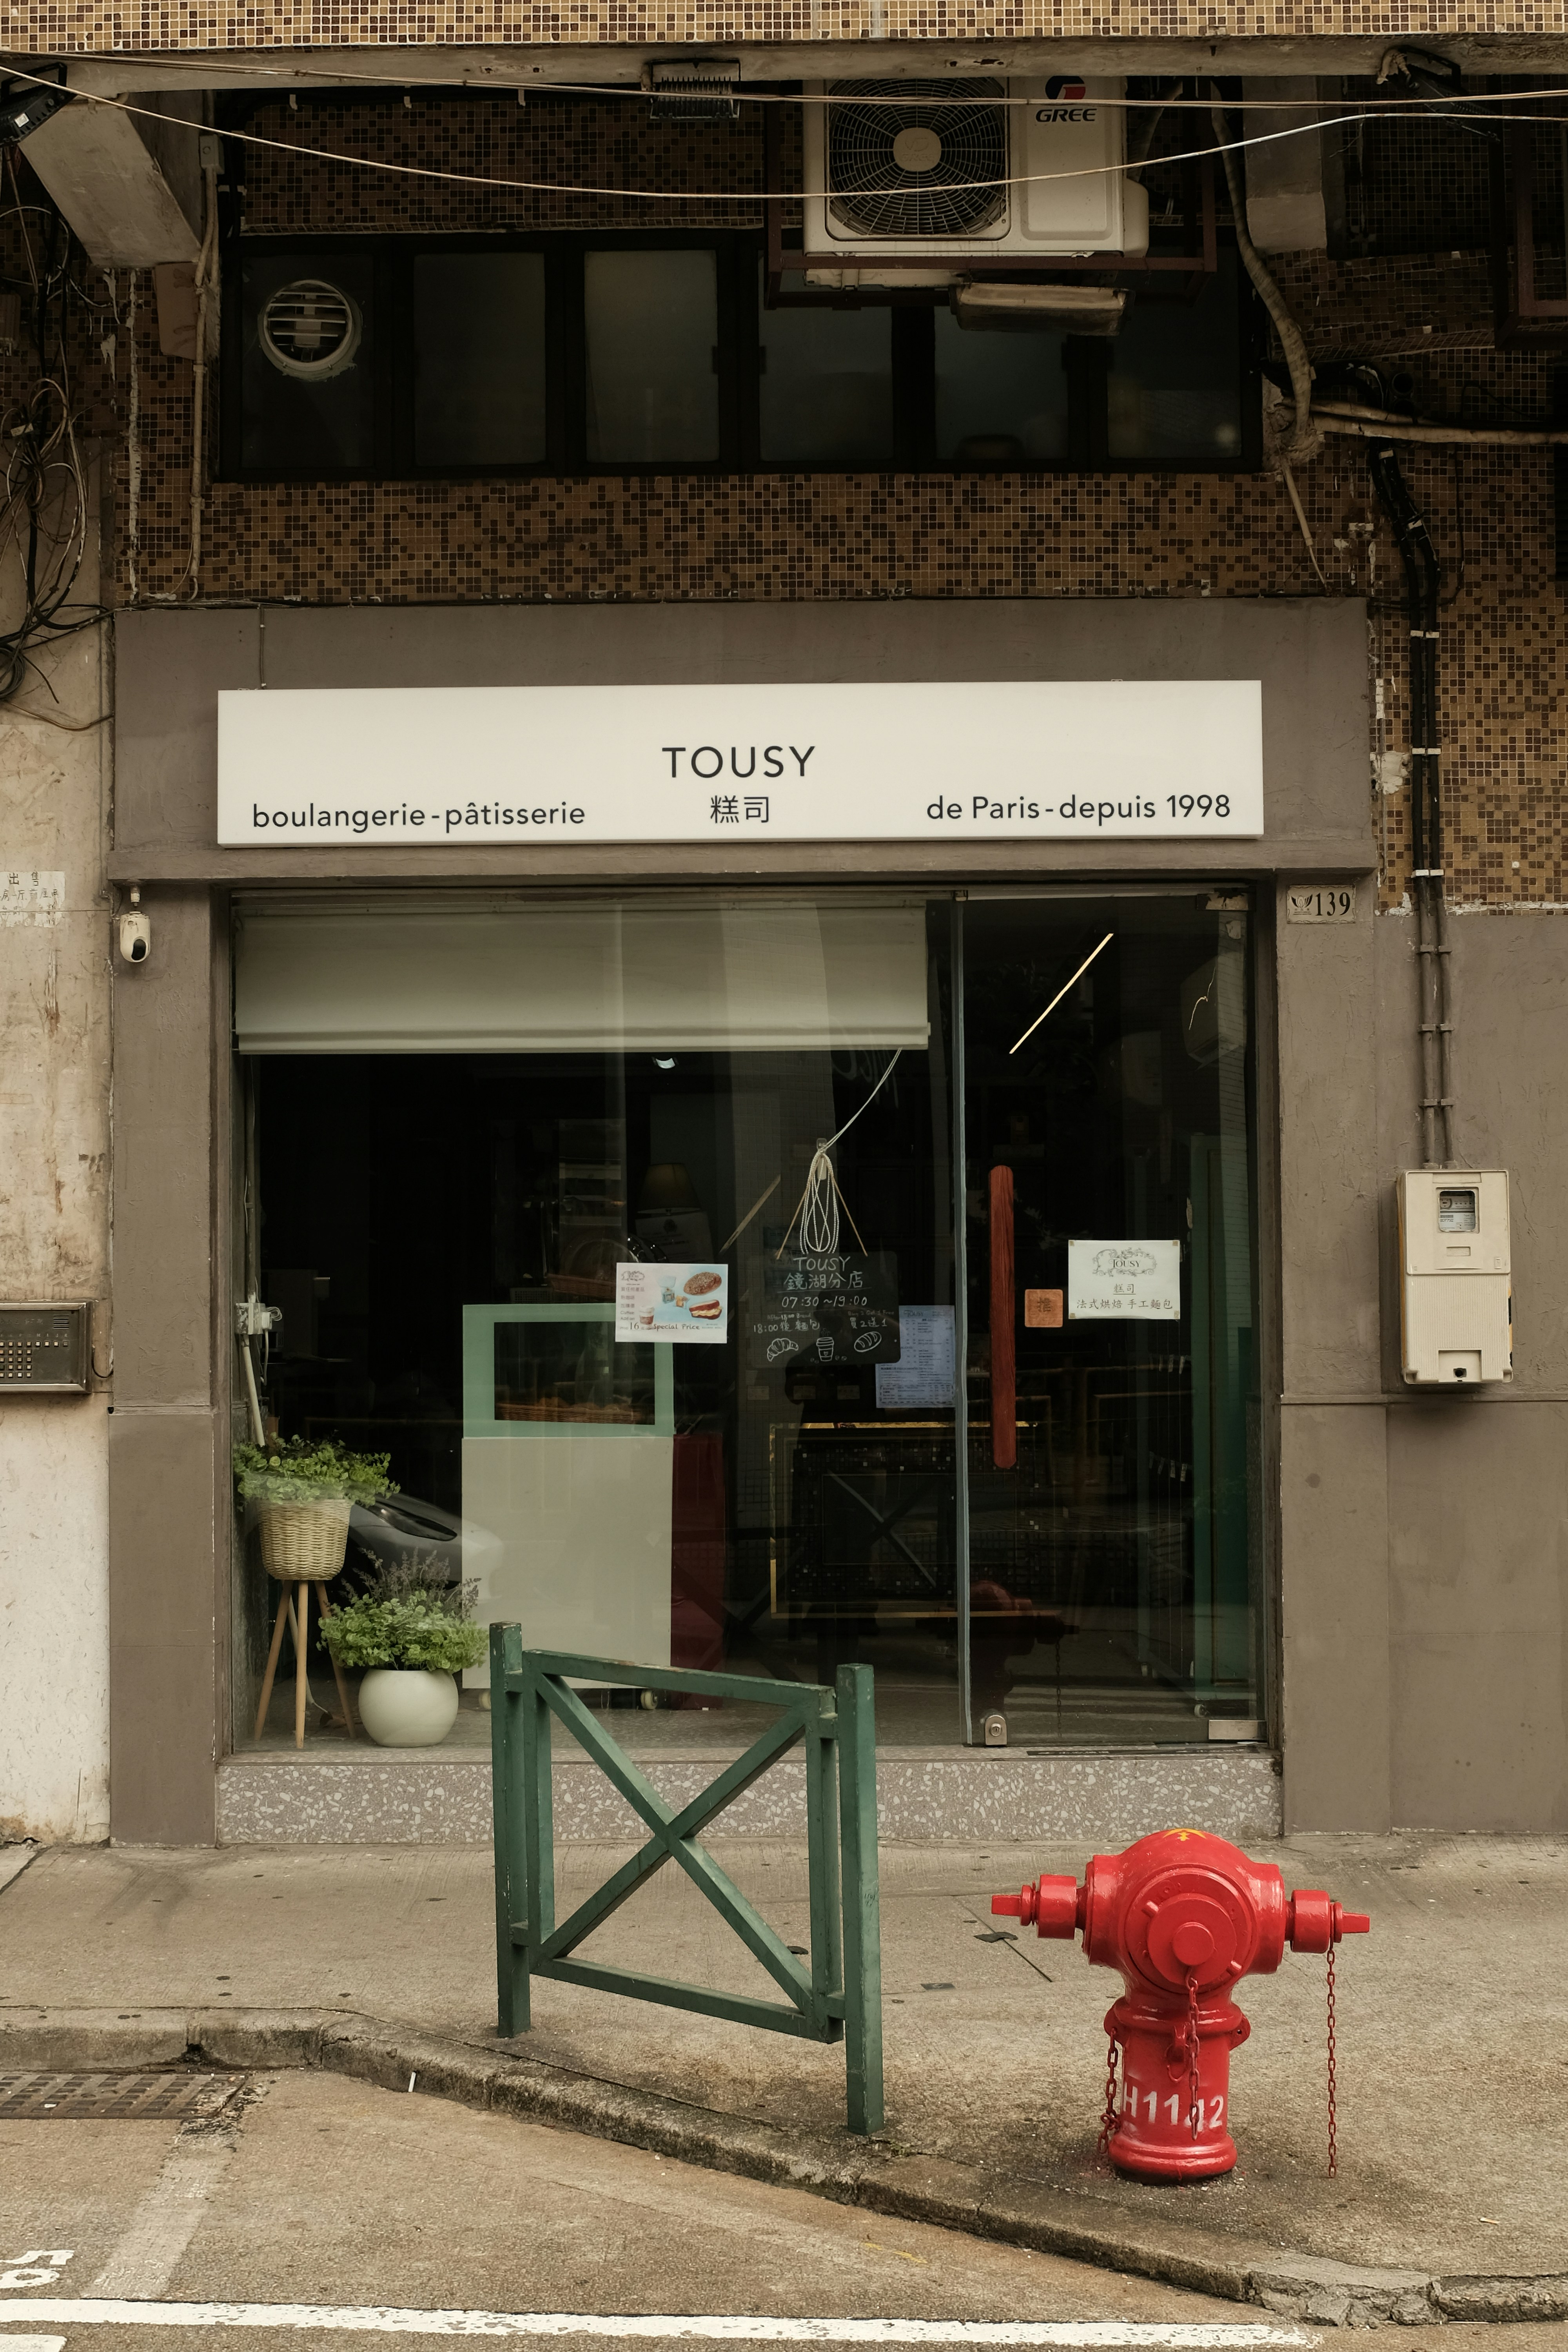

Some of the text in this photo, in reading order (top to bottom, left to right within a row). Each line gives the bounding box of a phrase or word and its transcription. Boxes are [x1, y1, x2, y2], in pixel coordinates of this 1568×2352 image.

[1036, 109, 1097, 122] GREE
[661, 746, 815, 778] TOUSY
[710, 795, 769, 824] 糕司
[927, 795, 962, 819] de
[1167, 794, 1230, 818] 1998
[9, 871, 39, 886] 出售
[1315, 892, 1351, 916] 139
[793, 1256, 851, 1271] TOUSY
[1109, 1259, 1141, 1268] TOUSY
[784, 1271, 863, 1290] 鏡湖分店
[1114, 1284, 1134, 1293] 糕司
[1077, 1299, 1172, 1309] 法式烘焙 手工麵包
